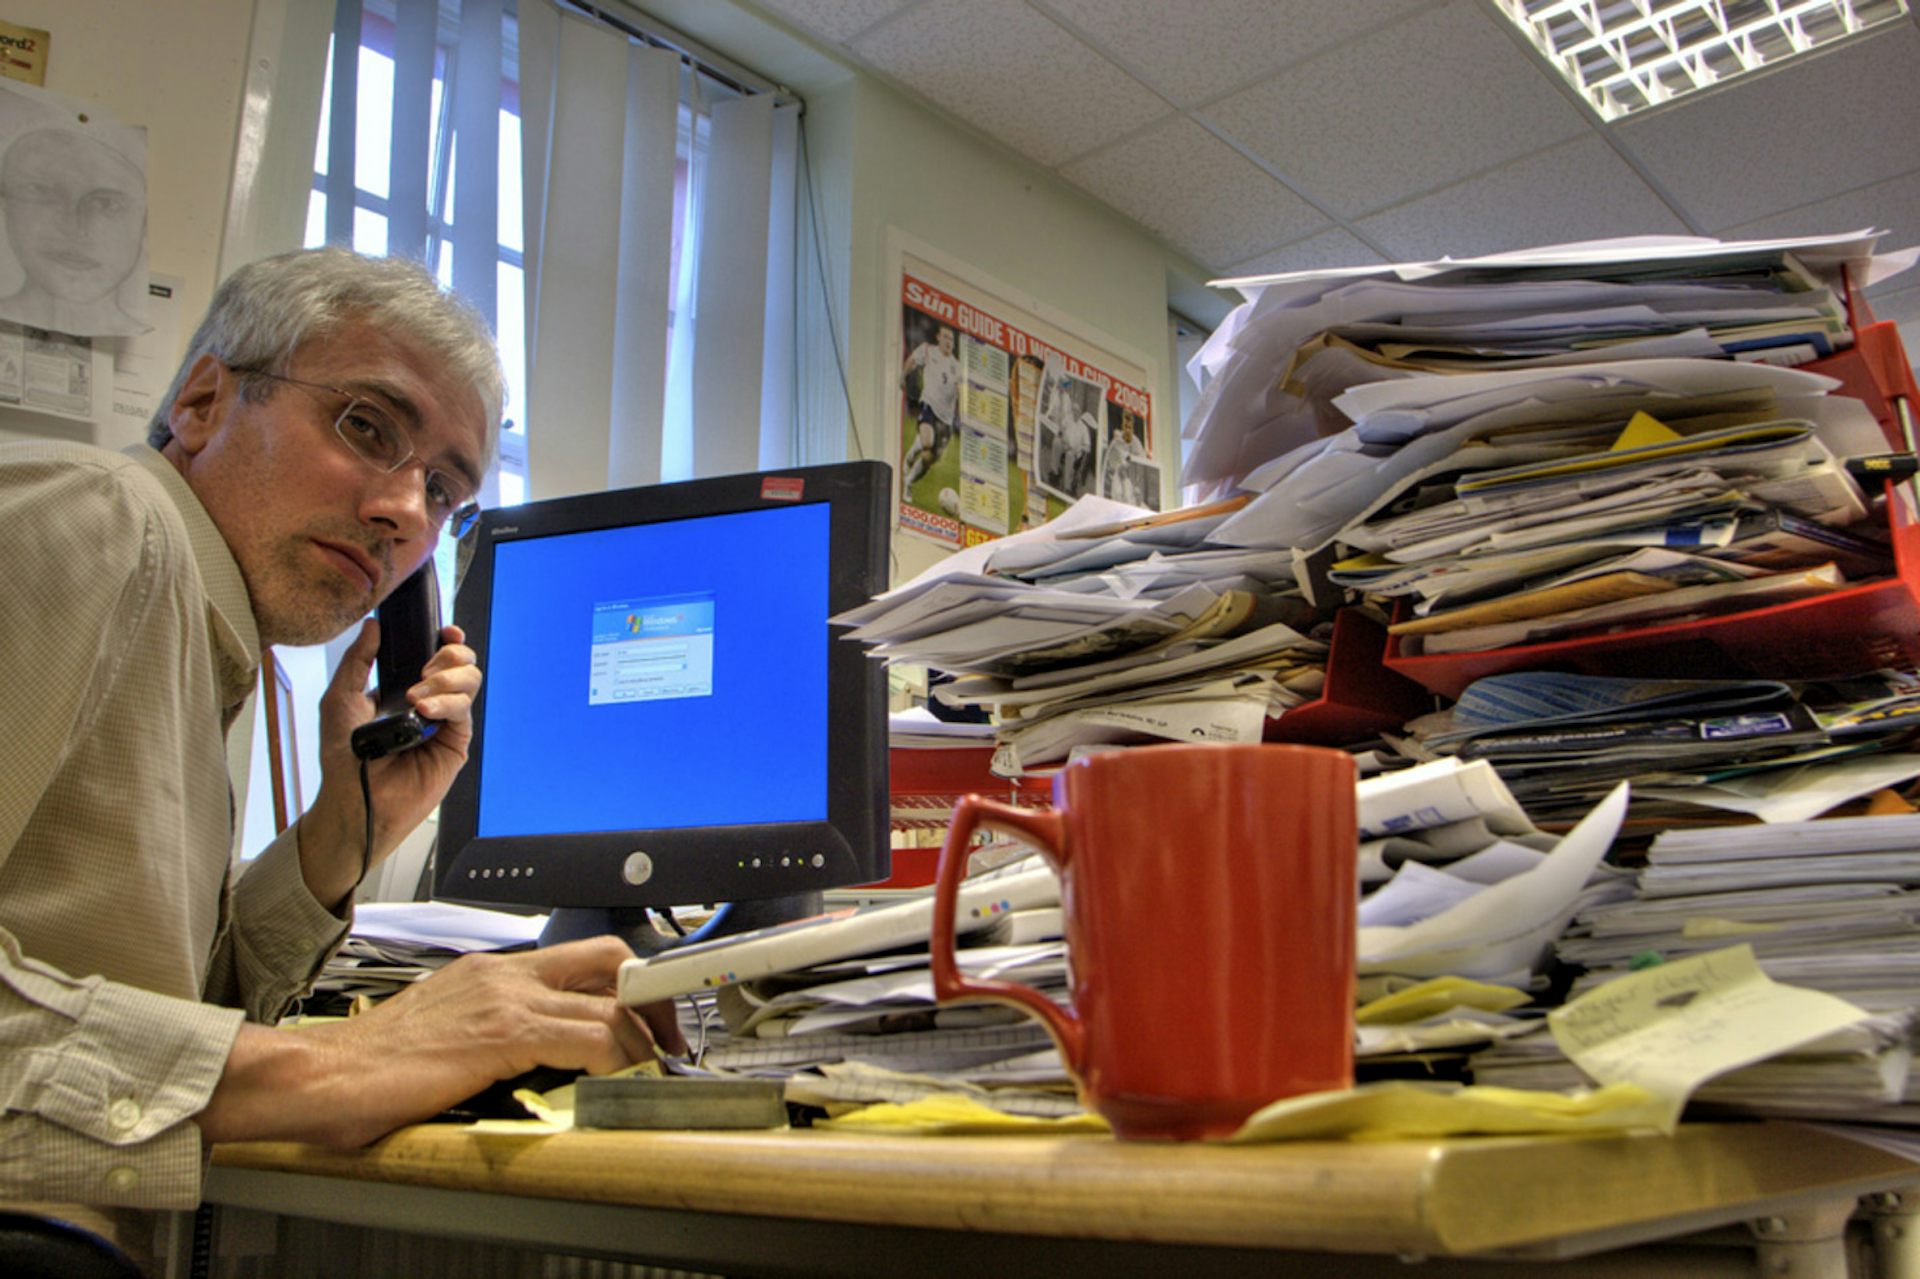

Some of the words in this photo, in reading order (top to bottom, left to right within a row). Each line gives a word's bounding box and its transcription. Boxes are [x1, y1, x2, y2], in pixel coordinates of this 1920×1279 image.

[904, 281, 955, 320] Sun
[957, 303, 1005, 346] GUIDE
[1007, 326, 1027, 354] TO
[1030, 338, 1082, 377] WLD
[1114, 382, 1149, 419] 2006
